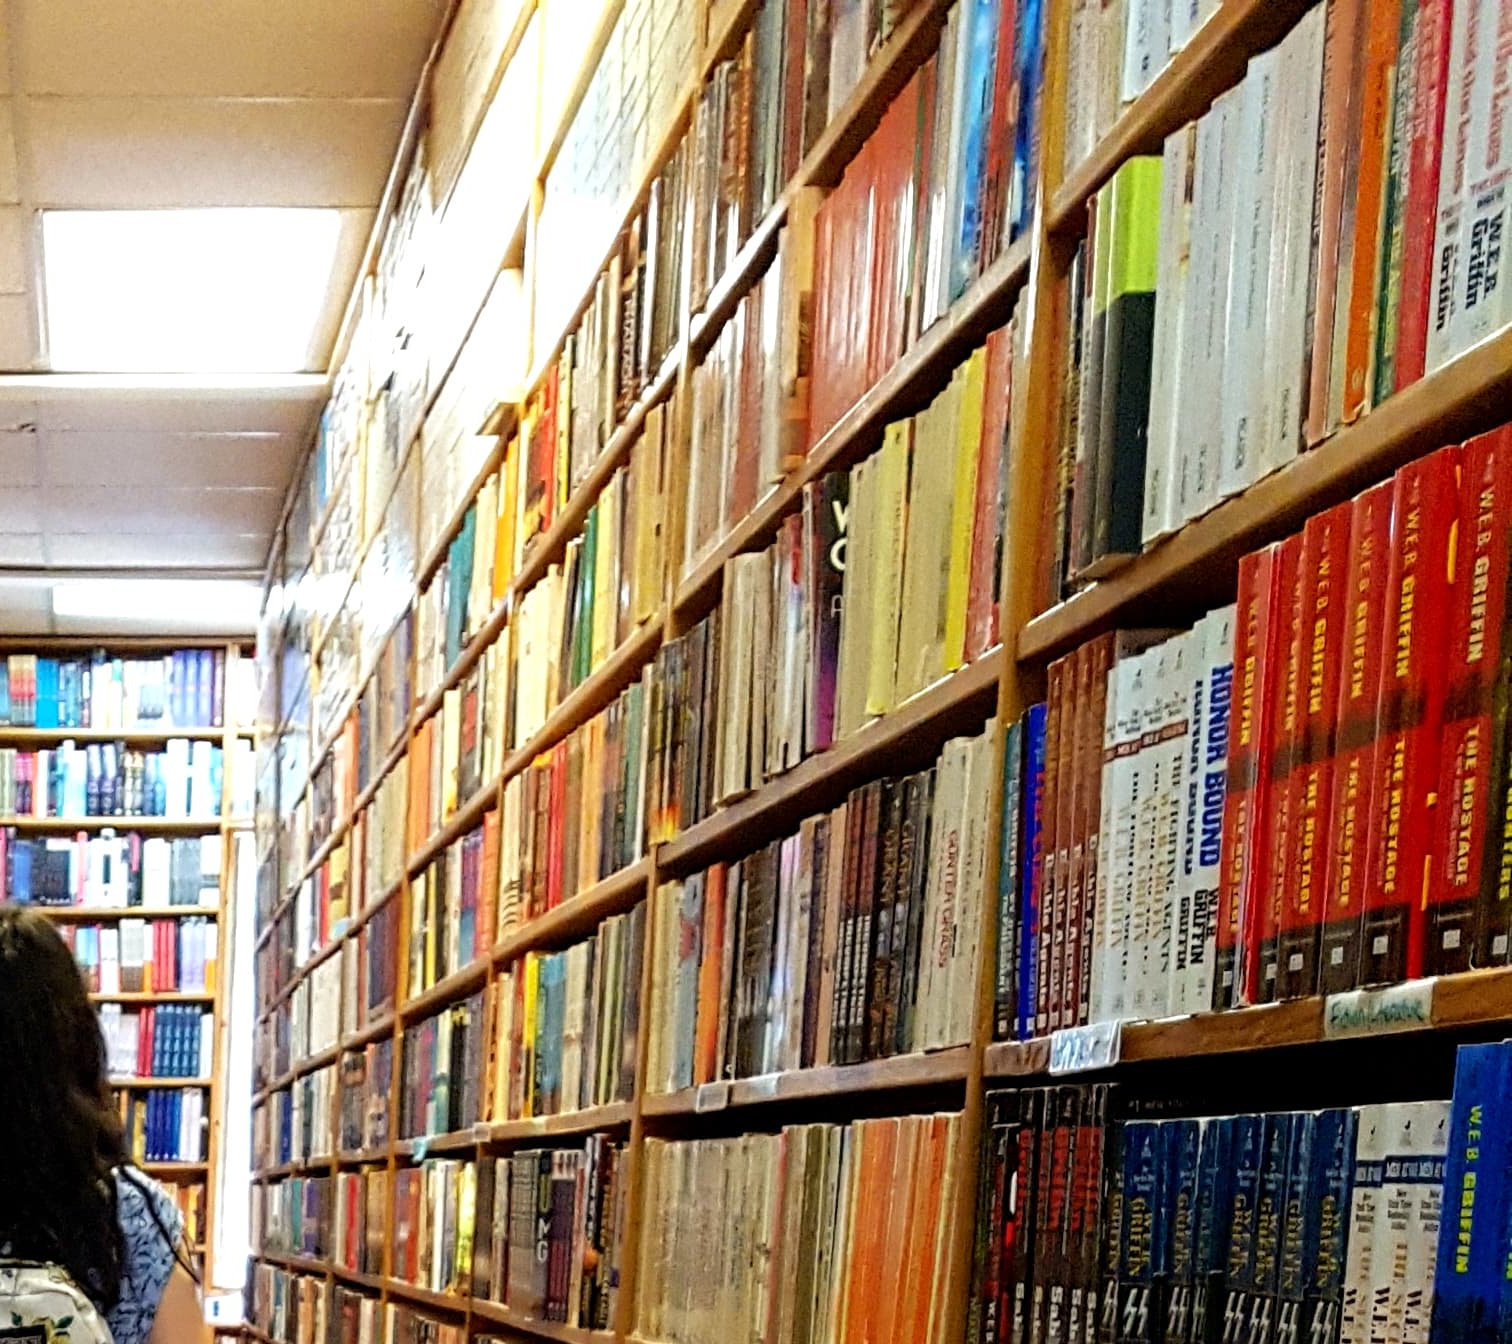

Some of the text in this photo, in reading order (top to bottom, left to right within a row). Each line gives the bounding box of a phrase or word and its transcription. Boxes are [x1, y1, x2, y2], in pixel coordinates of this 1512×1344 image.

[1464, 217, 1488, 310] Griffin
[1349, 600, 1369, 700] GRIFFIN
[1394, 574, 1415, 680] GRIFFIN
[1465, 555, 1492, 665] GRIFFIN
[1308, 616, 1328, 716] GRIFFIN
[1198, 664, 1235, 869] HONOR BOUND
[1384, 737, 1406, 897] THE HOSTAGE
[1453, 725, 1481, 888] THE HOSTAGE
[1298, 811, 1316, 914] HOSTAGE
[1337, 799, 1357, 908] HOSTAGE
[1189, 889, 1209, 965] GRIFFIN
[1455, 1104, 1484, 1276] W.E.B. GRIFFIN
